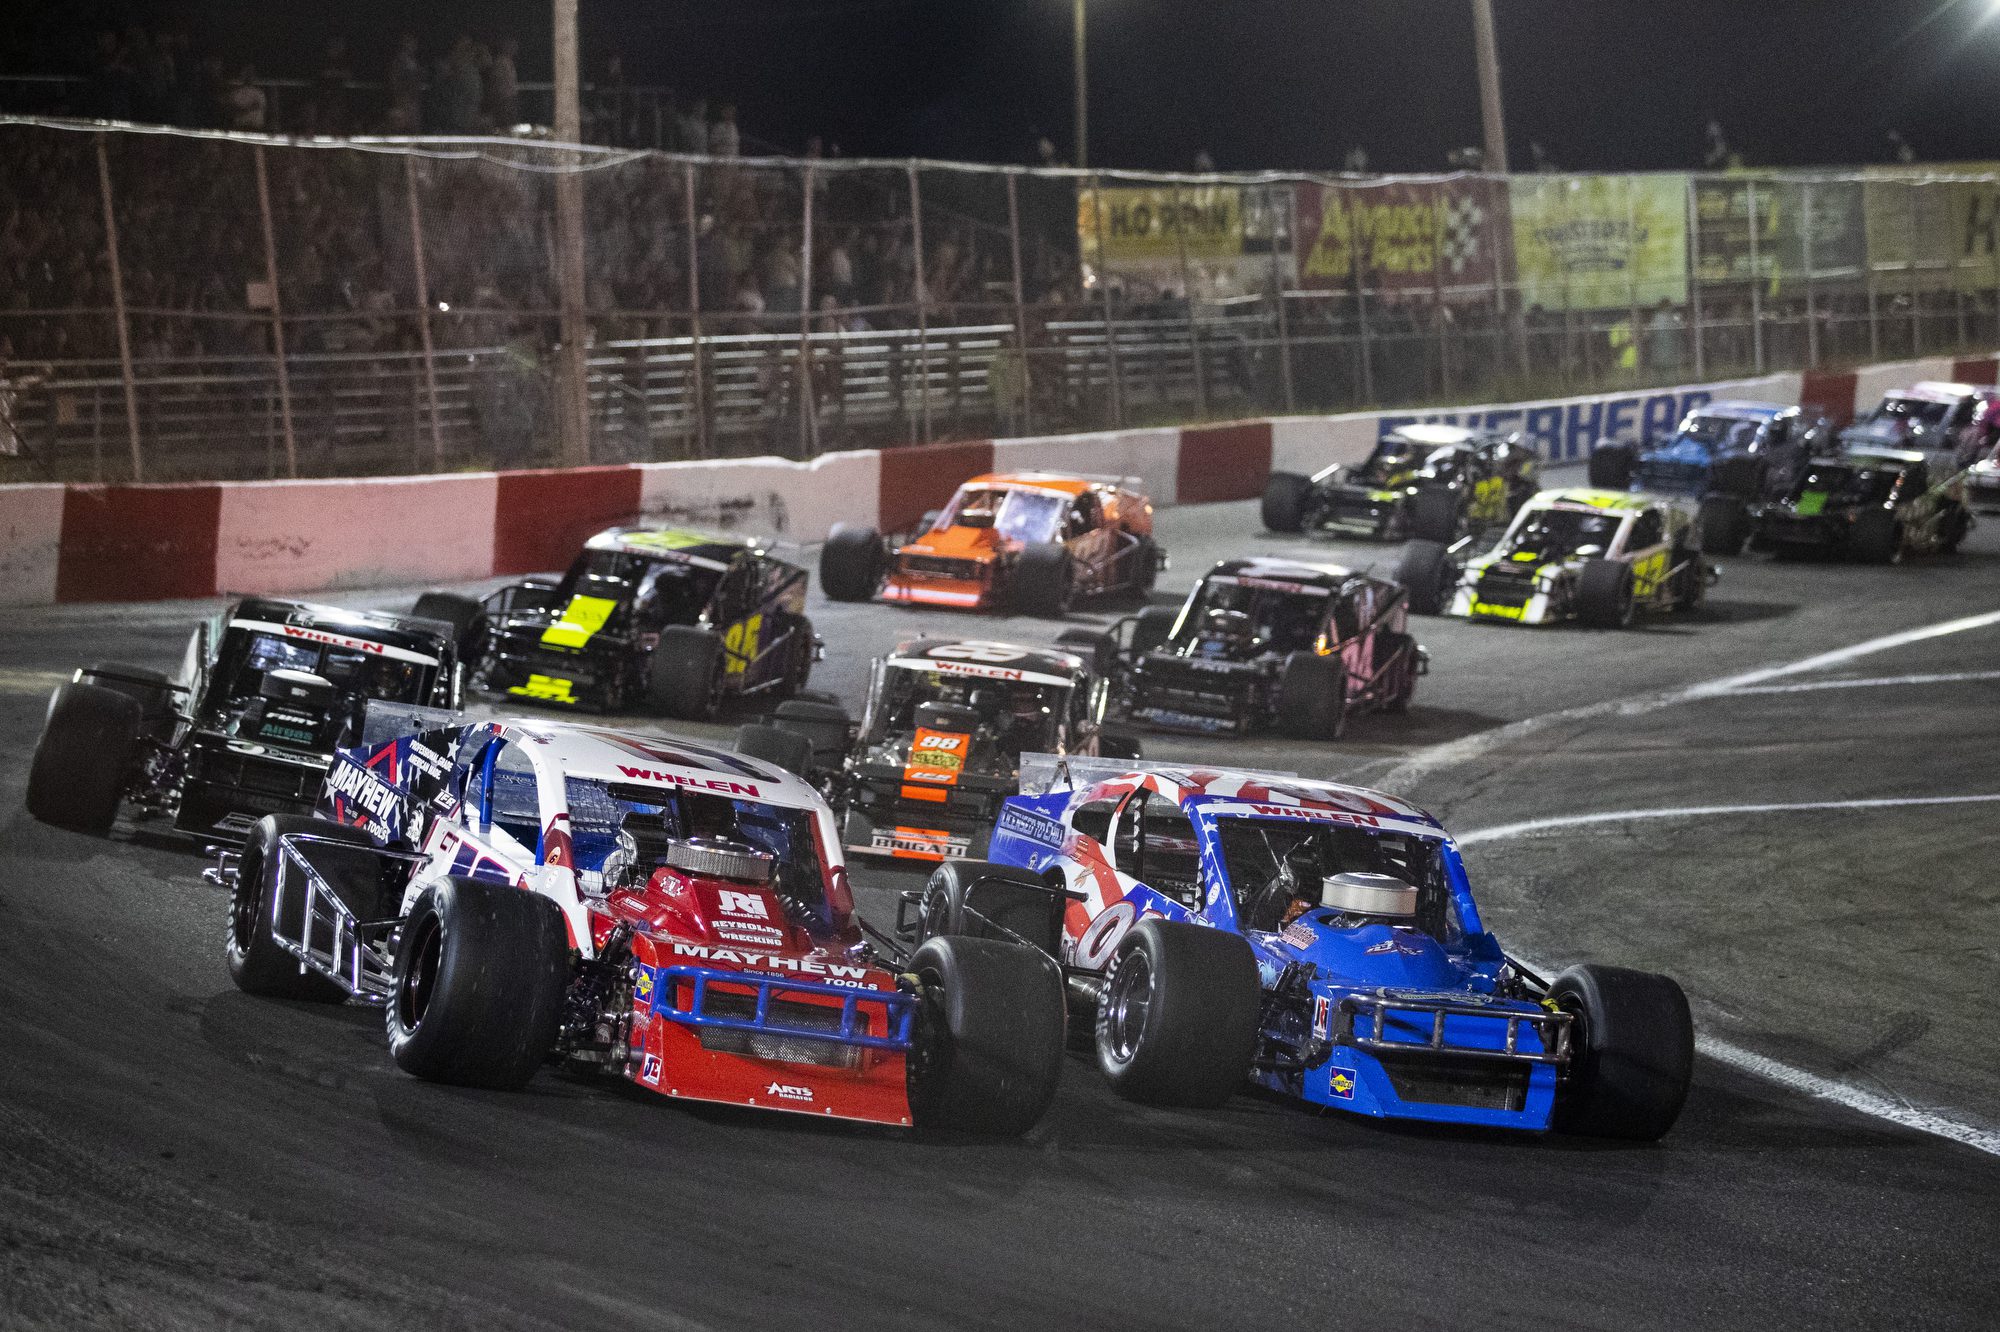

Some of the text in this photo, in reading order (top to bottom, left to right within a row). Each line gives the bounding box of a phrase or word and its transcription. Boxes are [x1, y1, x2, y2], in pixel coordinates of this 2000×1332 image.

[282, 624, 384, 654] WHELEN
[935, 660, 1023, 680] WHELEN
[920, 735, 961, 750] 98
[329, 759, 400, 821] MAYHEW
[616, 764, 761, 798] WHELEN
[1250, 804, 1380, 827] WHELEN
[366, 821, 388, 841] TOOLS
[875, 837, 964, 856] BRIGATI
[718, 889, 769, 915] JRi
[720, 910, 762, 920] shocks
[712, 920, 783, 937] REYNOLDS
[719, 931, 783, 946] WRECKING
[673, 943, 867, 979] MAYHEW
[743, 967, 765, 976] Since
[824, 977, 878, 991] TOOLS
[764, 1081, 813, 1095] ARTS
[1330, 1079, 1354, 1090] SUNOCO
[778, 1092, 814, 1102] RADIATOR
